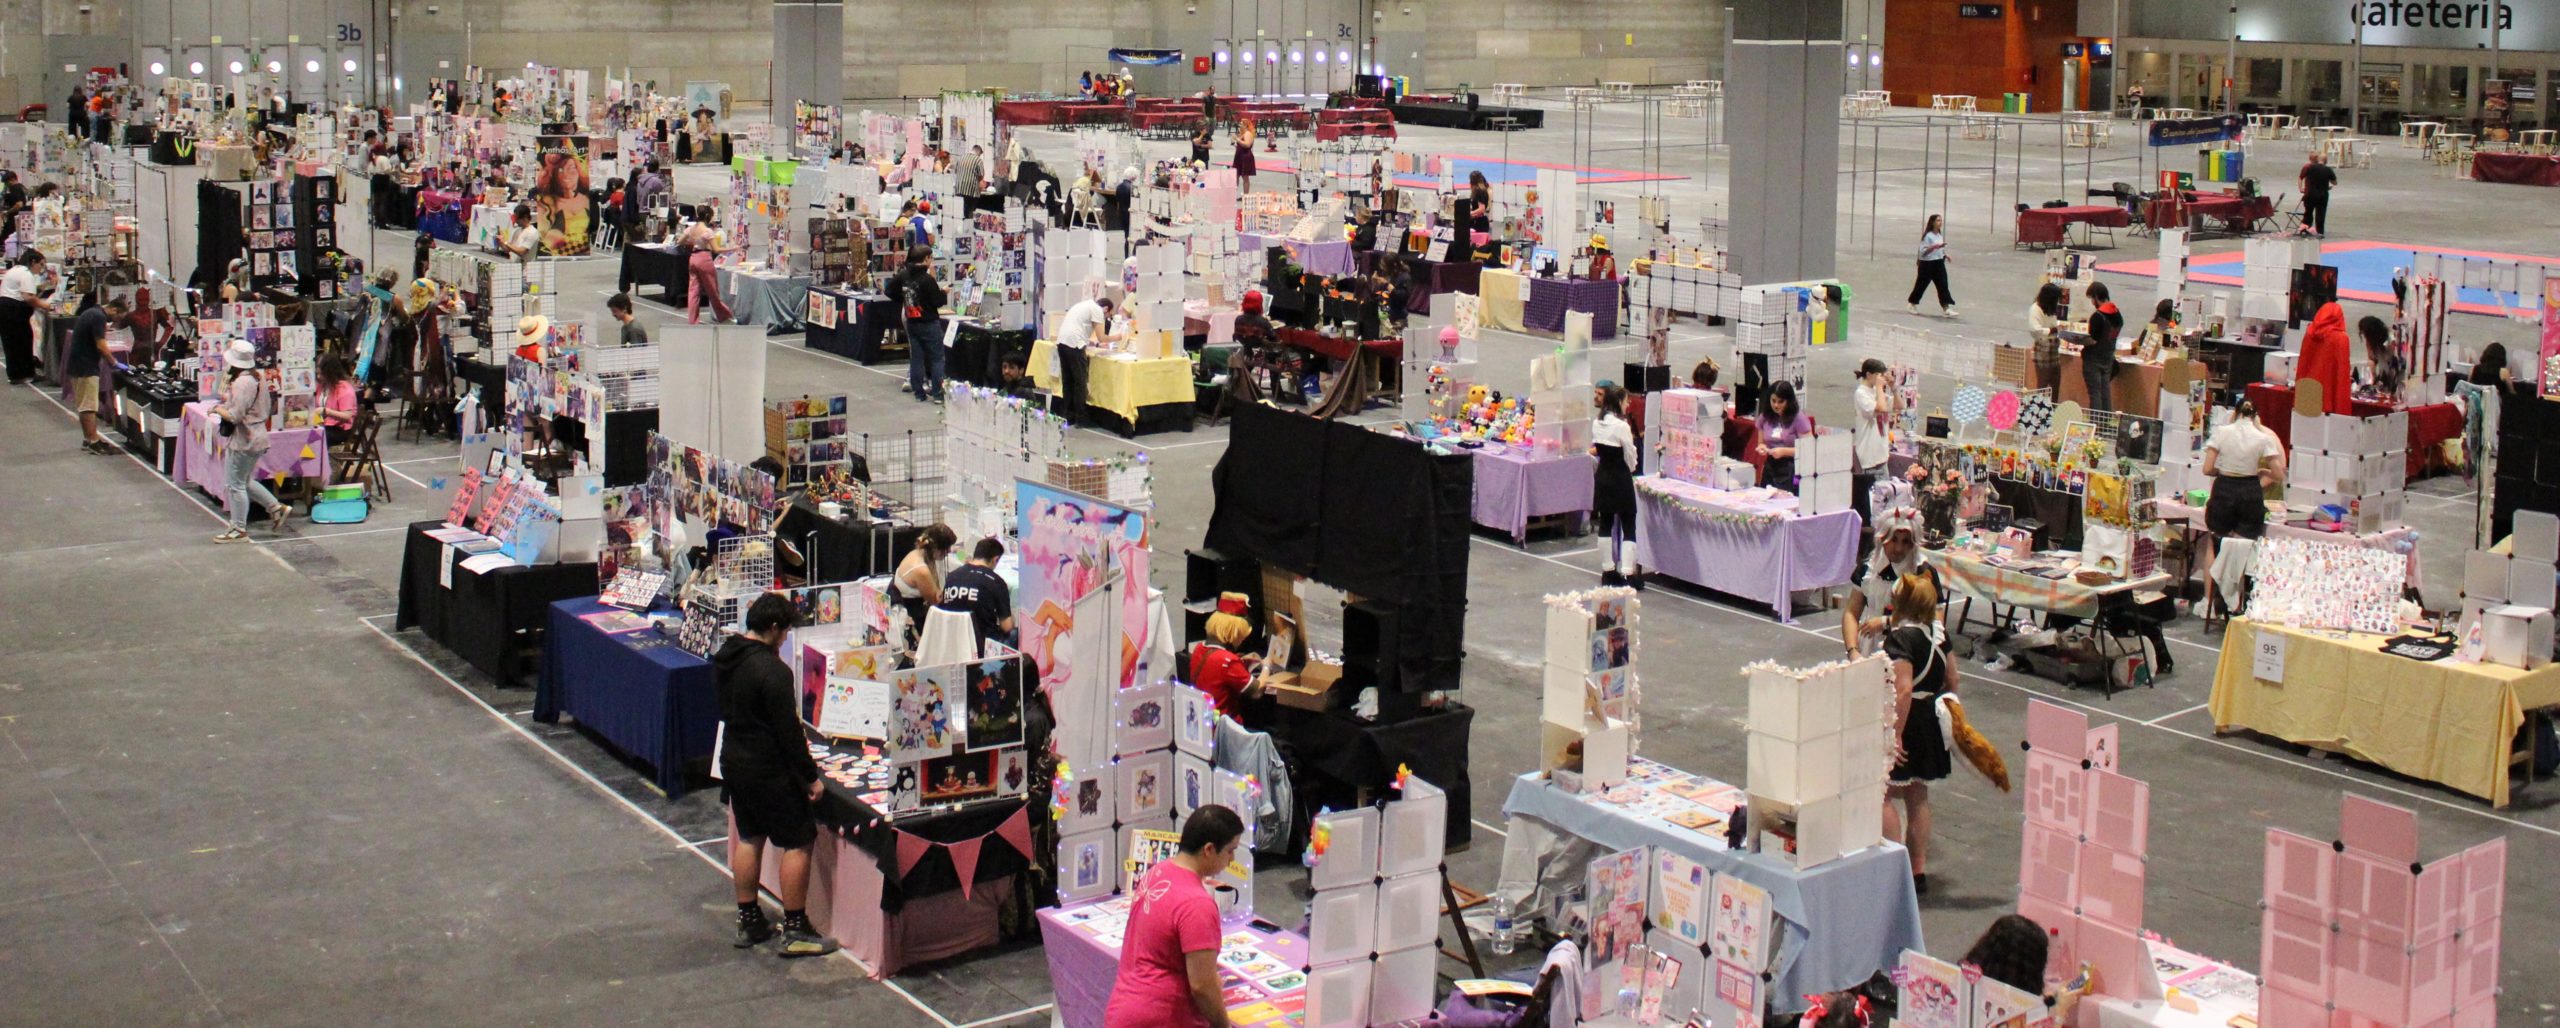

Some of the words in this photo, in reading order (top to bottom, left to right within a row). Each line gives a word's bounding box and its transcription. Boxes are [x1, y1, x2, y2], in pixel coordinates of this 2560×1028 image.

[337, 22, 362, 41] 3b
[1338, 23, 1352, 37] 3c
[944, 585, 979, 601] HOPE
[2263, 643, 2277, 656] 95
